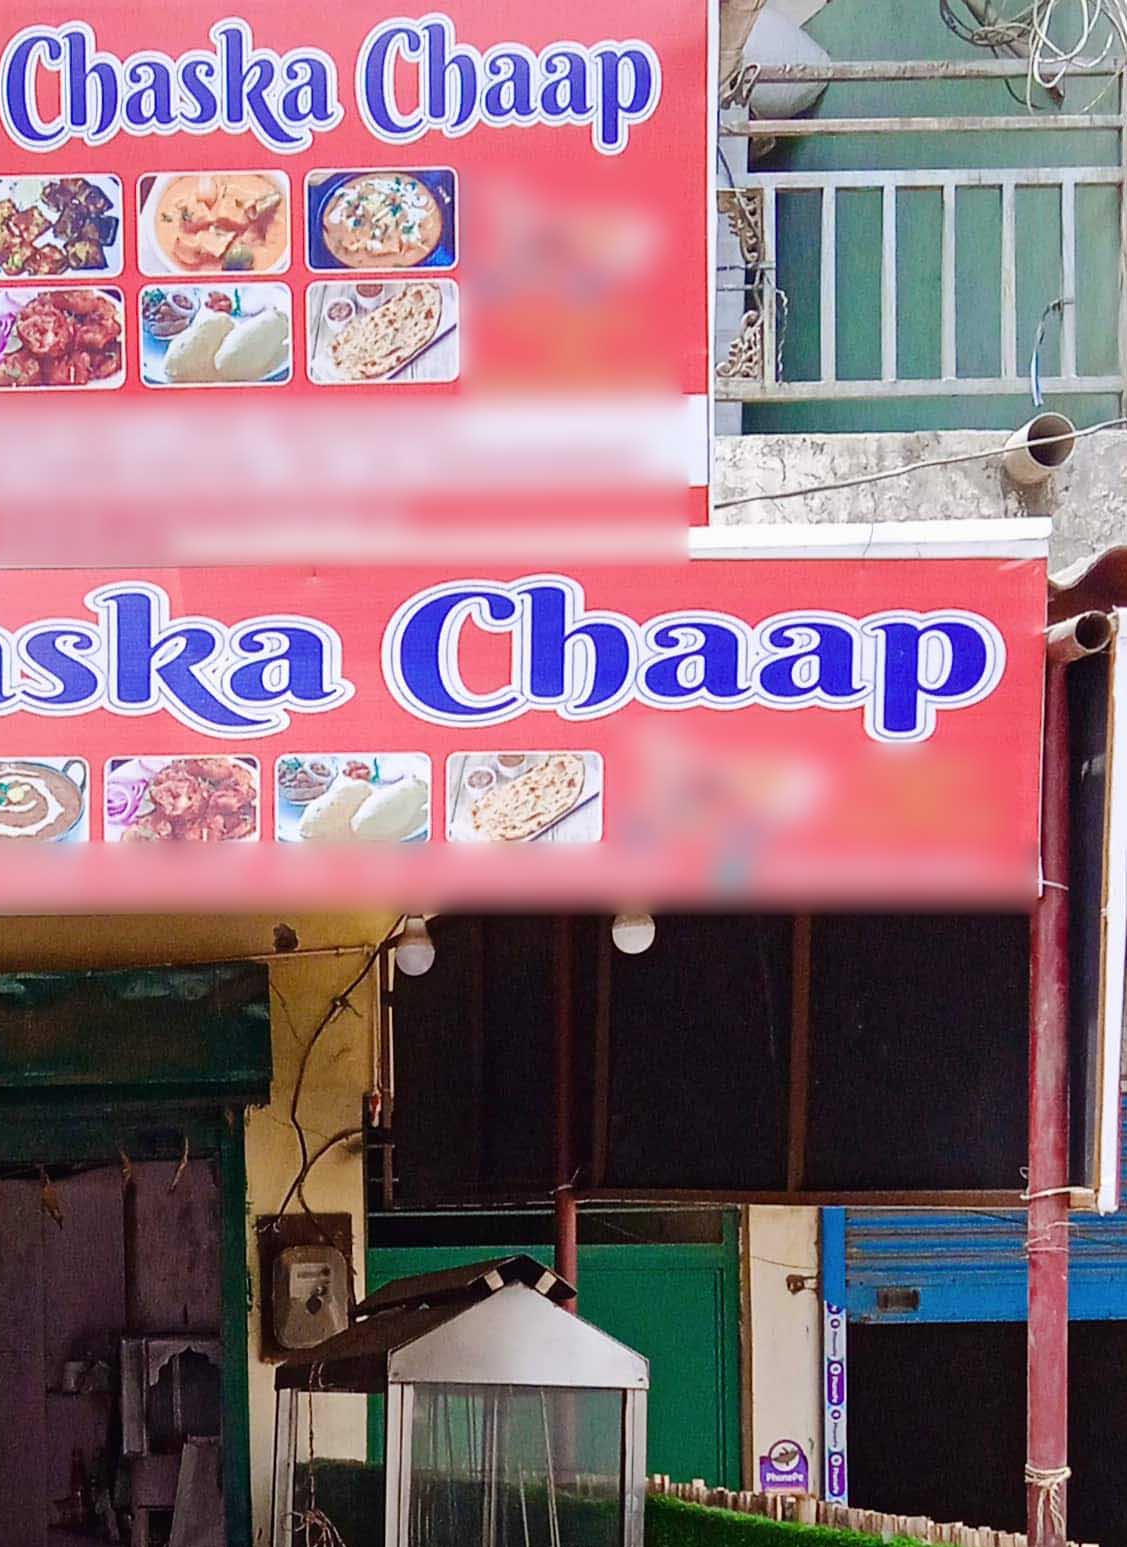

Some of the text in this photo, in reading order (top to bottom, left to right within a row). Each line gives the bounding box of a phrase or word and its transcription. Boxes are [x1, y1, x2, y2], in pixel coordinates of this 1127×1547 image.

[0, 17, 335, 152] Chaska
[358, 12, 663, 153] Chaap
[381, 574, 1006, 742] Chaap
